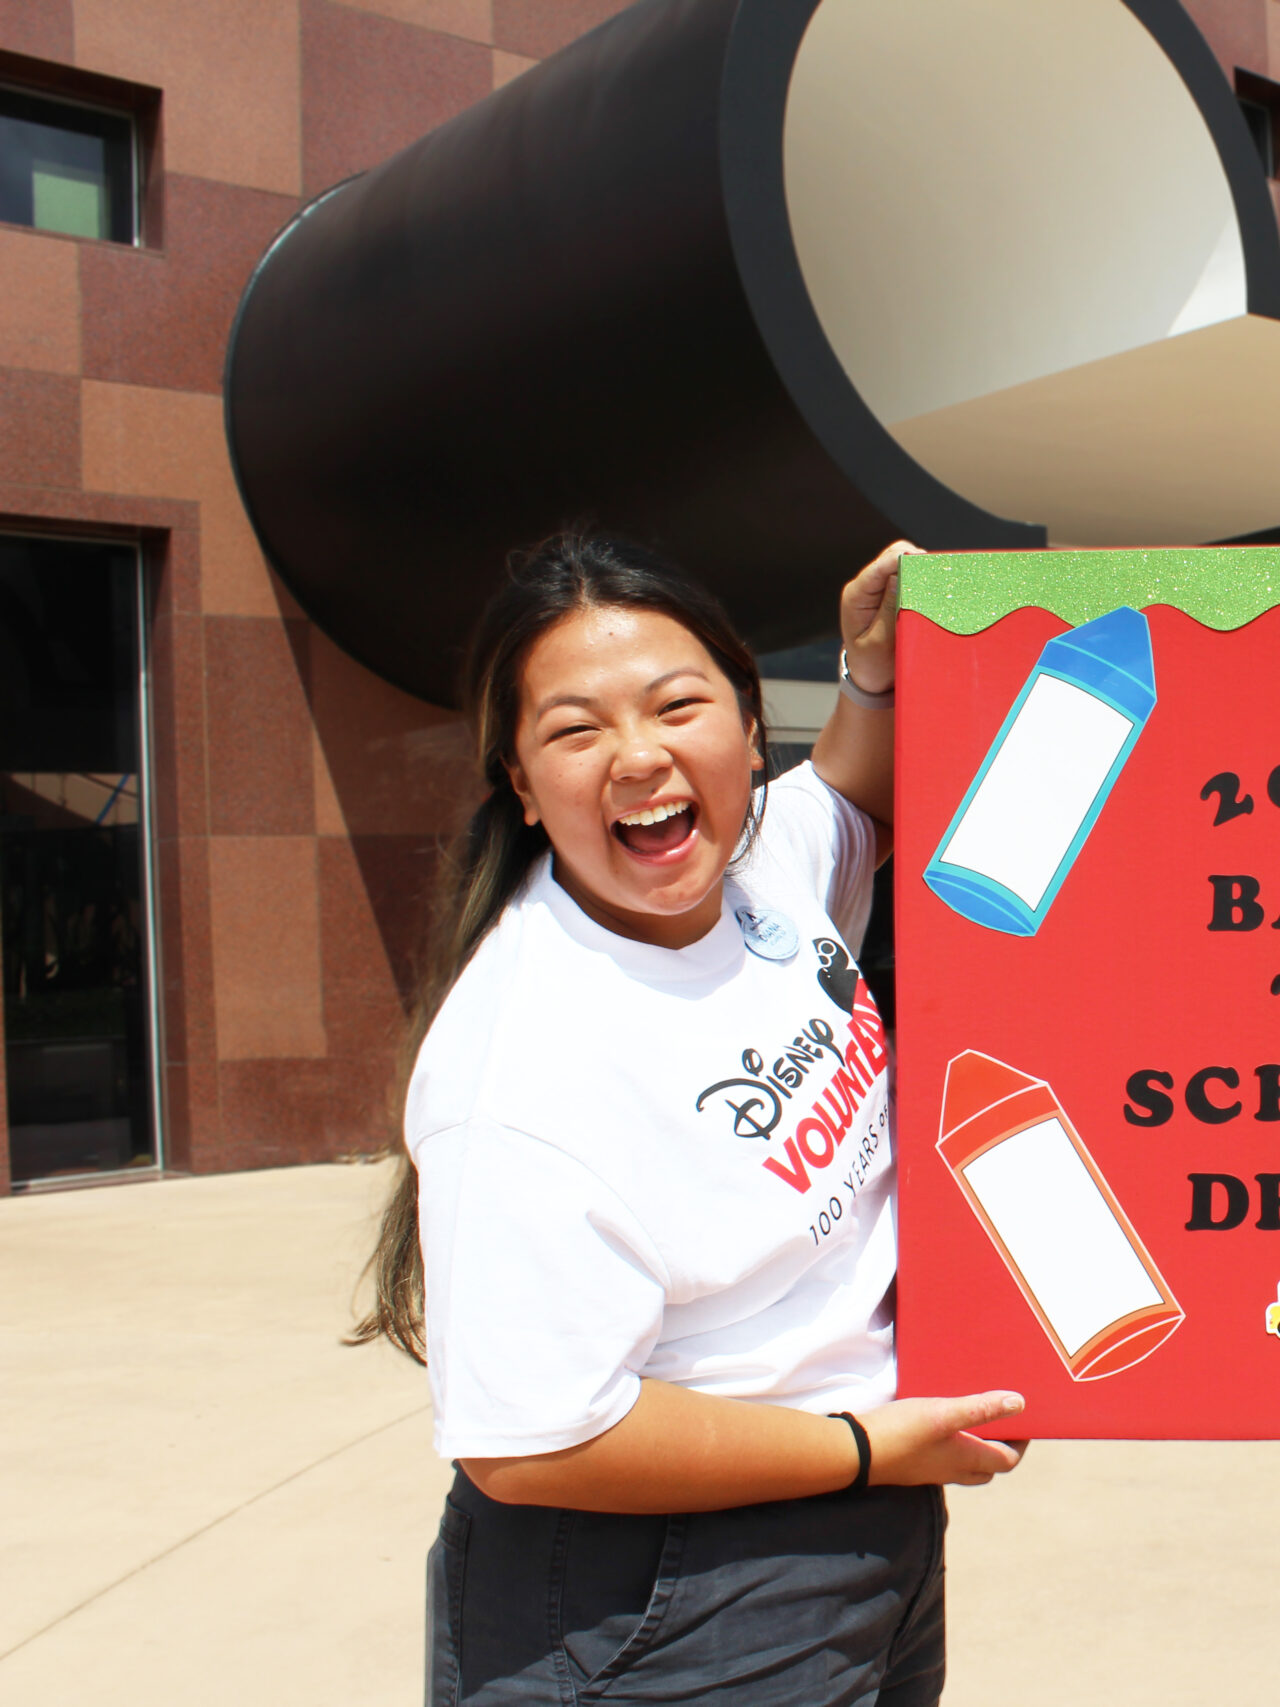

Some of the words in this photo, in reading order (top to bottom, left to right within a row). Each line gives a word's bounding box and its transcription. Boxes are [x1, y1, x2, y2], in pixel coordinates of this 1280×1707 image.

[762, 977, 888, 1195] VOLUNTEA
[809, 1196, 843, 1246] 100
[843, 1123, 879, 1198] YEARS
